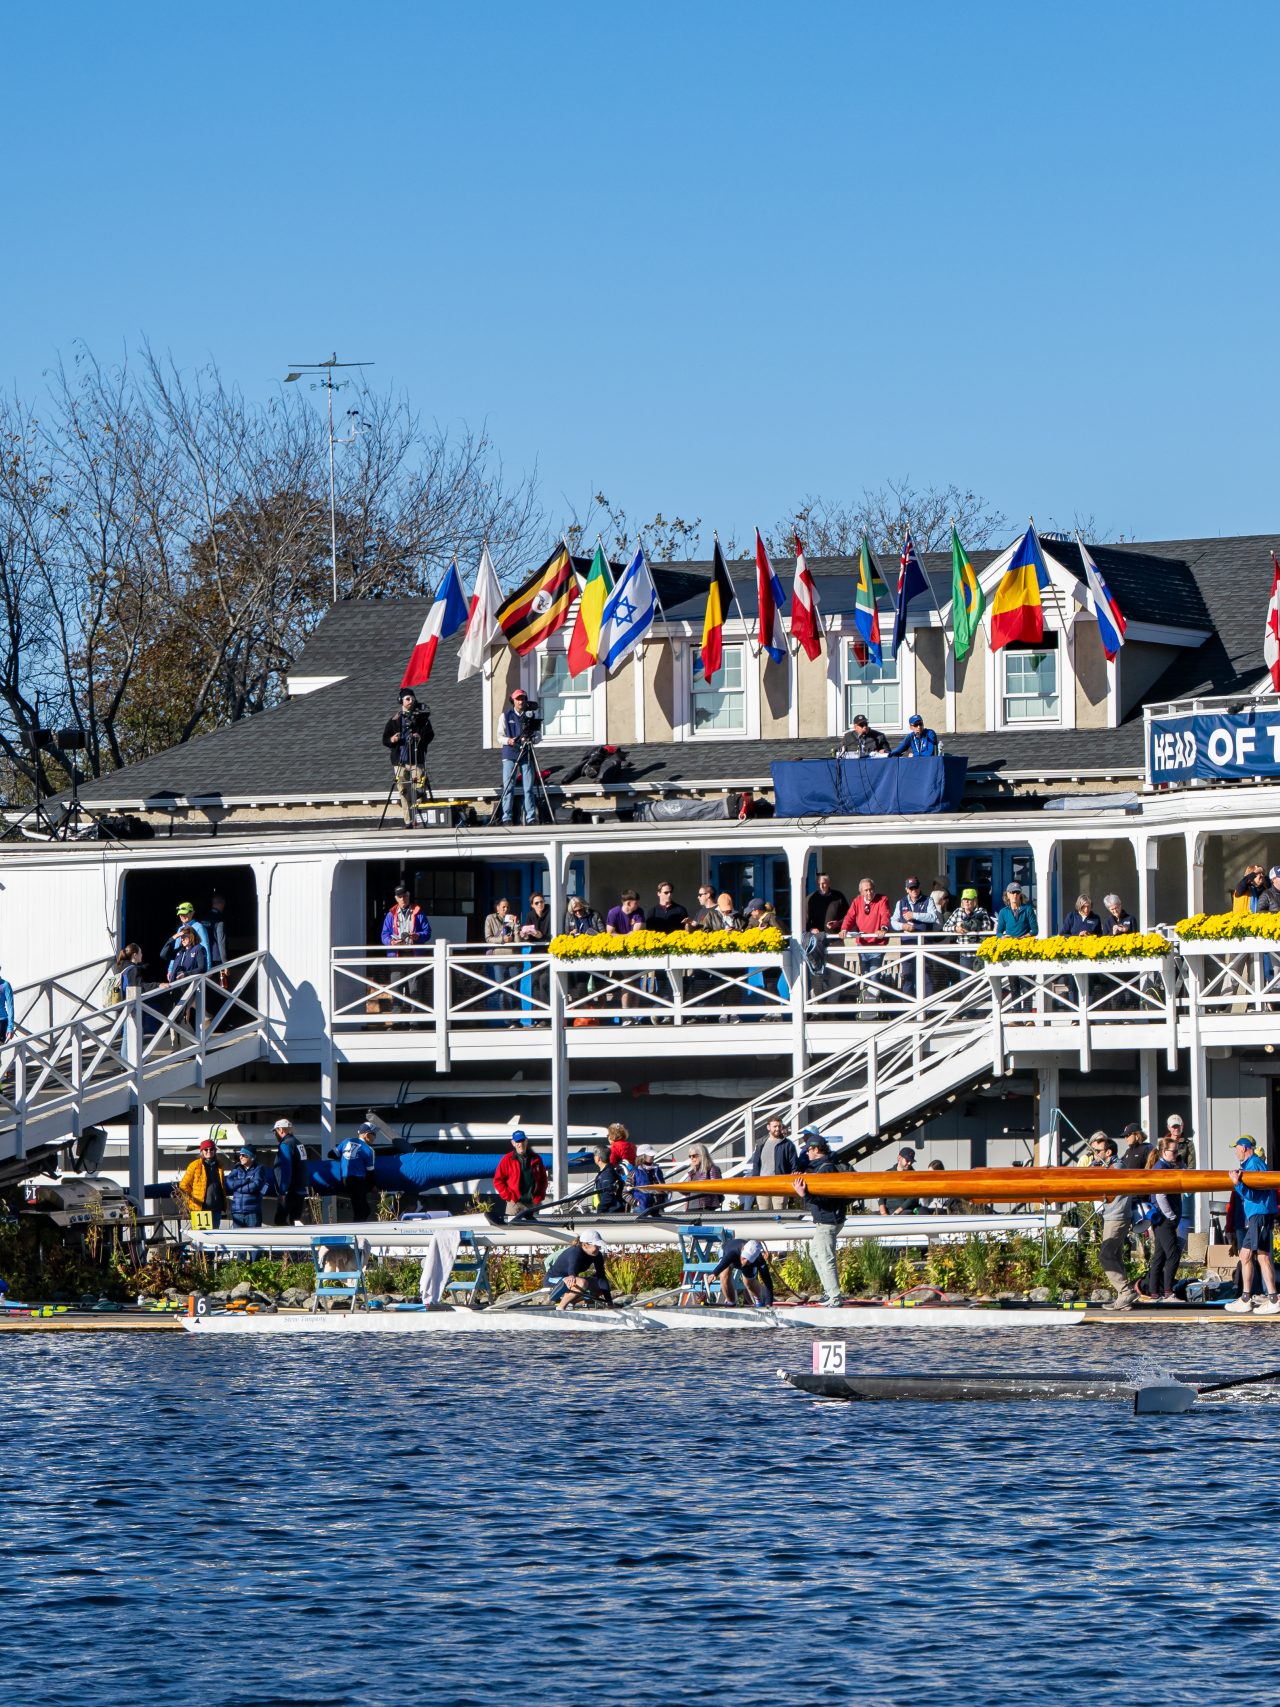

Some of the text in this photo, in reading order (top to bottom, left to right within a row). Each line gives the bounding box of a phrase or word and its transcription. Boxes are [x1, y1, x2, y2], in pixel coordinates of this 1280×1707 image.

[1154, 729, 1196, 771] HEAD
[1207, 726, 1256, 767] OF
[196, 1213, 210, 1227] 11
[197, 1298, 206, 1314] 6
[821, 1344, 843, 1368] 75
